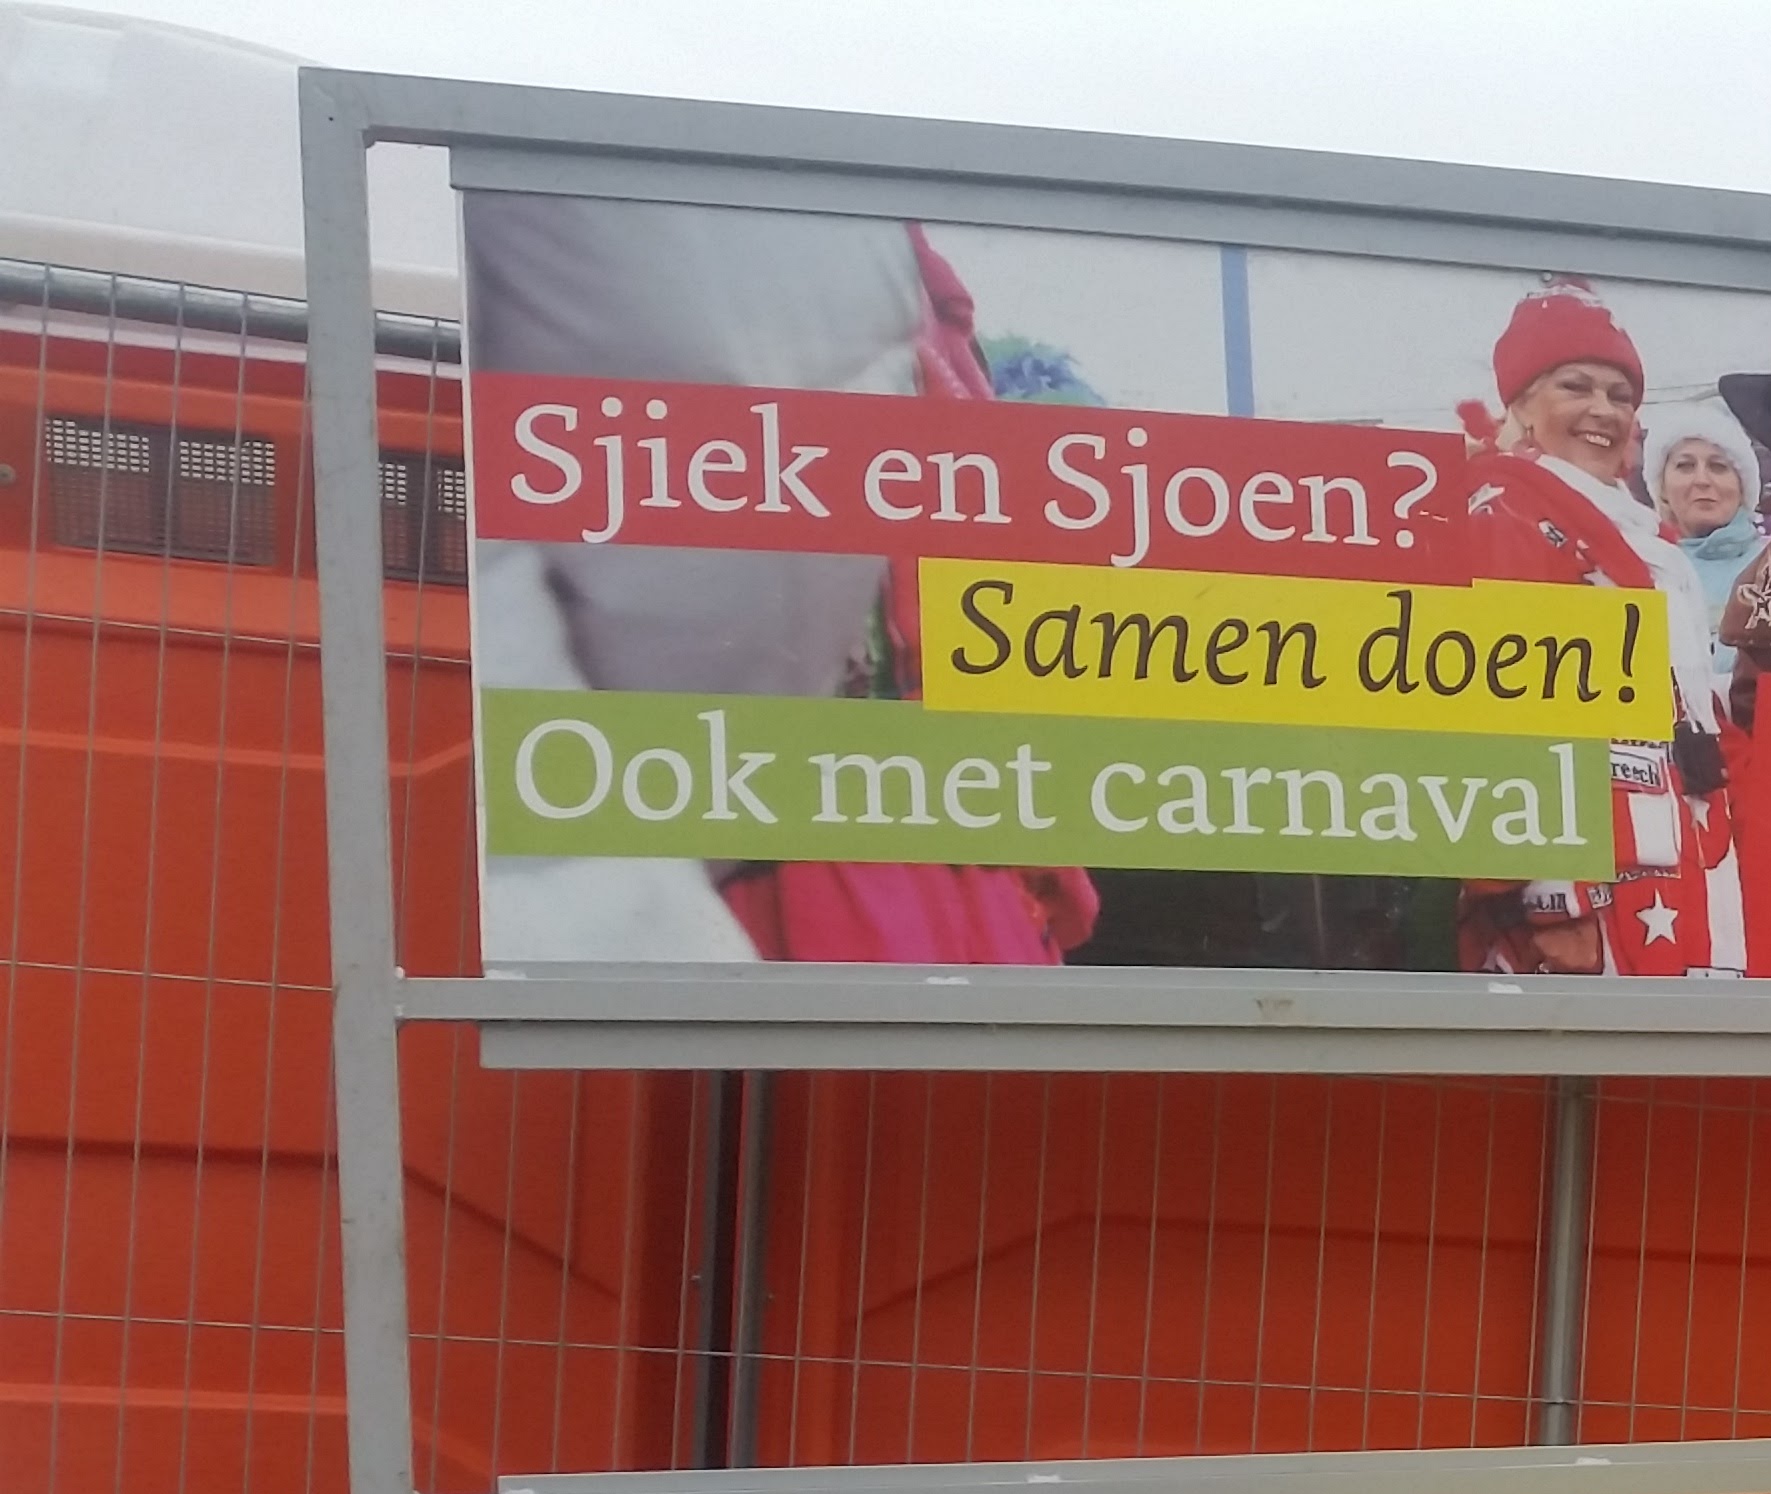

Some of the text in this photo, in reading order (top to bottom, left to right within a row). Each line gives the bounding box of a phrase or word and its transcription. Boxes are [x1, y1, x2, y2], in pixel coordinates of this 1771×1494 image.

[510, 396, 1438, 568] Sjiek en Sjoen?
[951, 579, 1640, 704] Samen doen!
[515, 709, 1588, 846] Ook met carnaval
